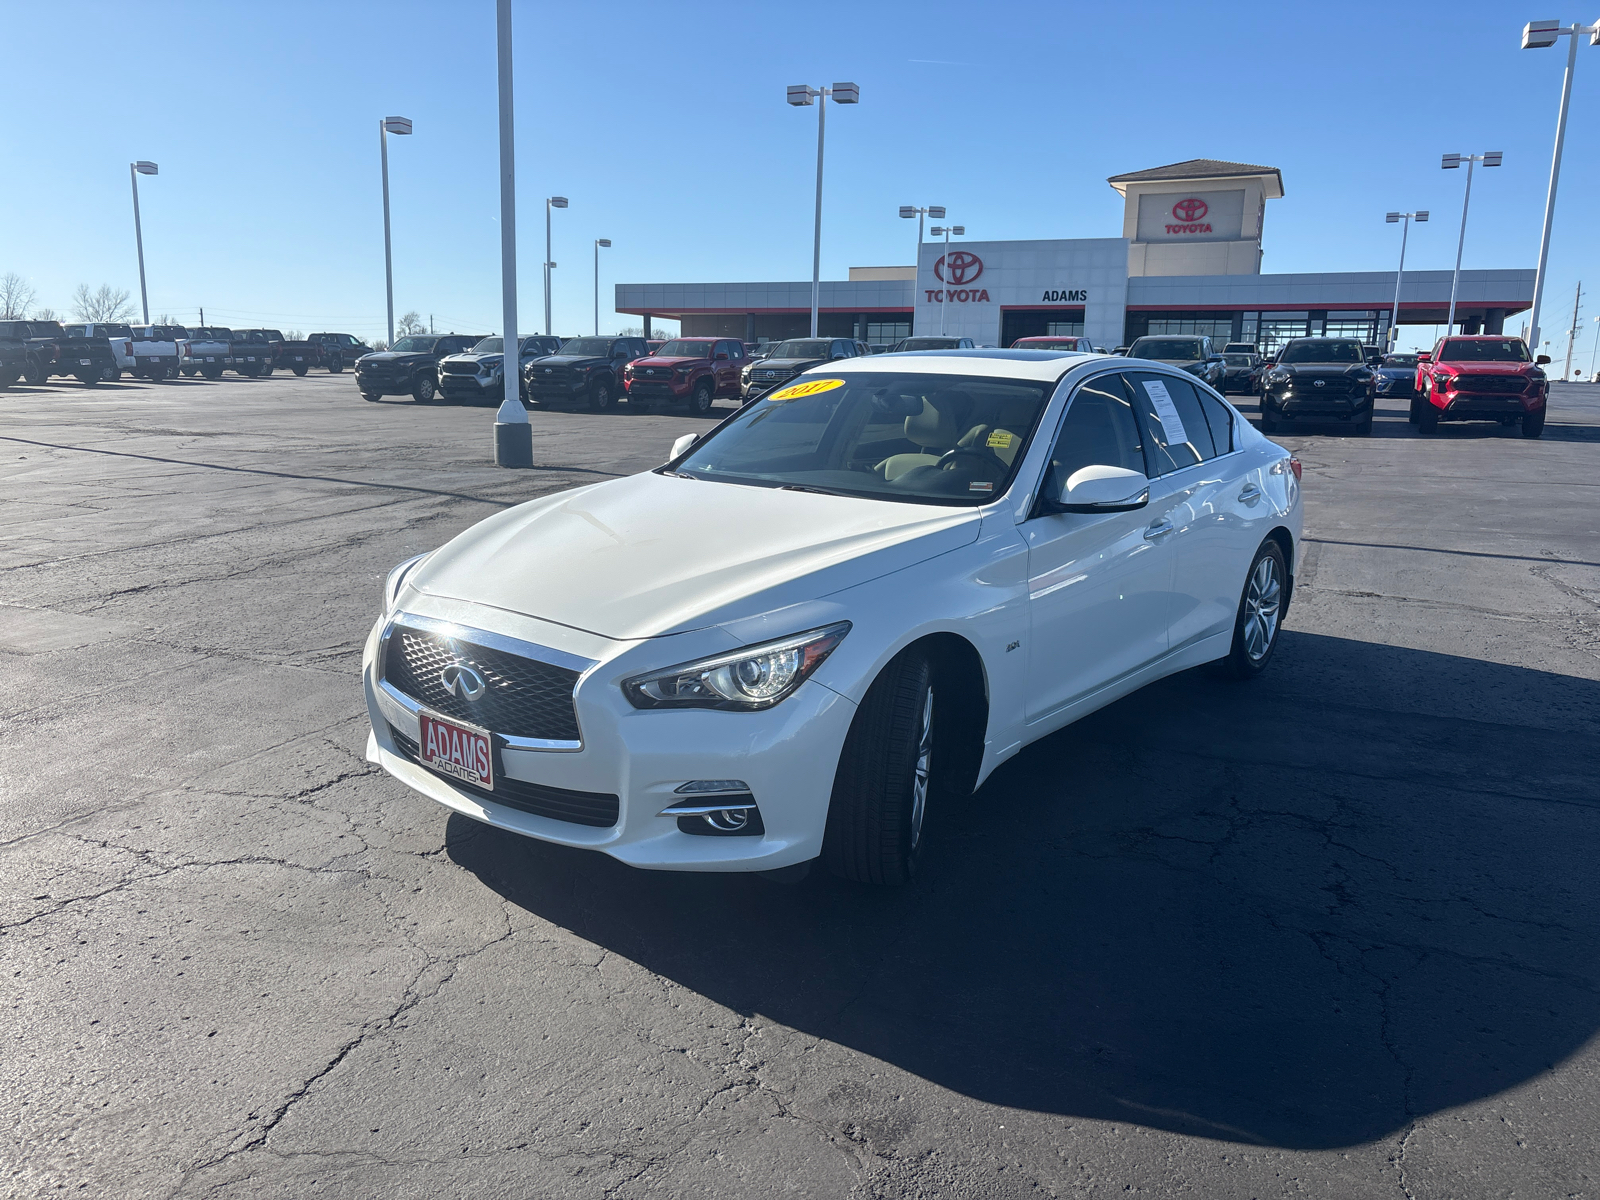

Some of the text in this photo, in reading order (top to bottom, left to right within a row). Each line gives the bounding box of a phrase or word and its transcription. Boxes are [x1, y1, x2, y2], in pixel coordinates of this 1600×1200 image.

[1165, 223, 1213, 234] TOYOTA
[924, 289, 990, 303] TOYOTA
[1042, 289, 1087, 302] ADAMS
[777, 381, 835, 399] 2017
[426, 721, 489, 778] ADAMS
[437, 759, 477, 783] ADAMS
